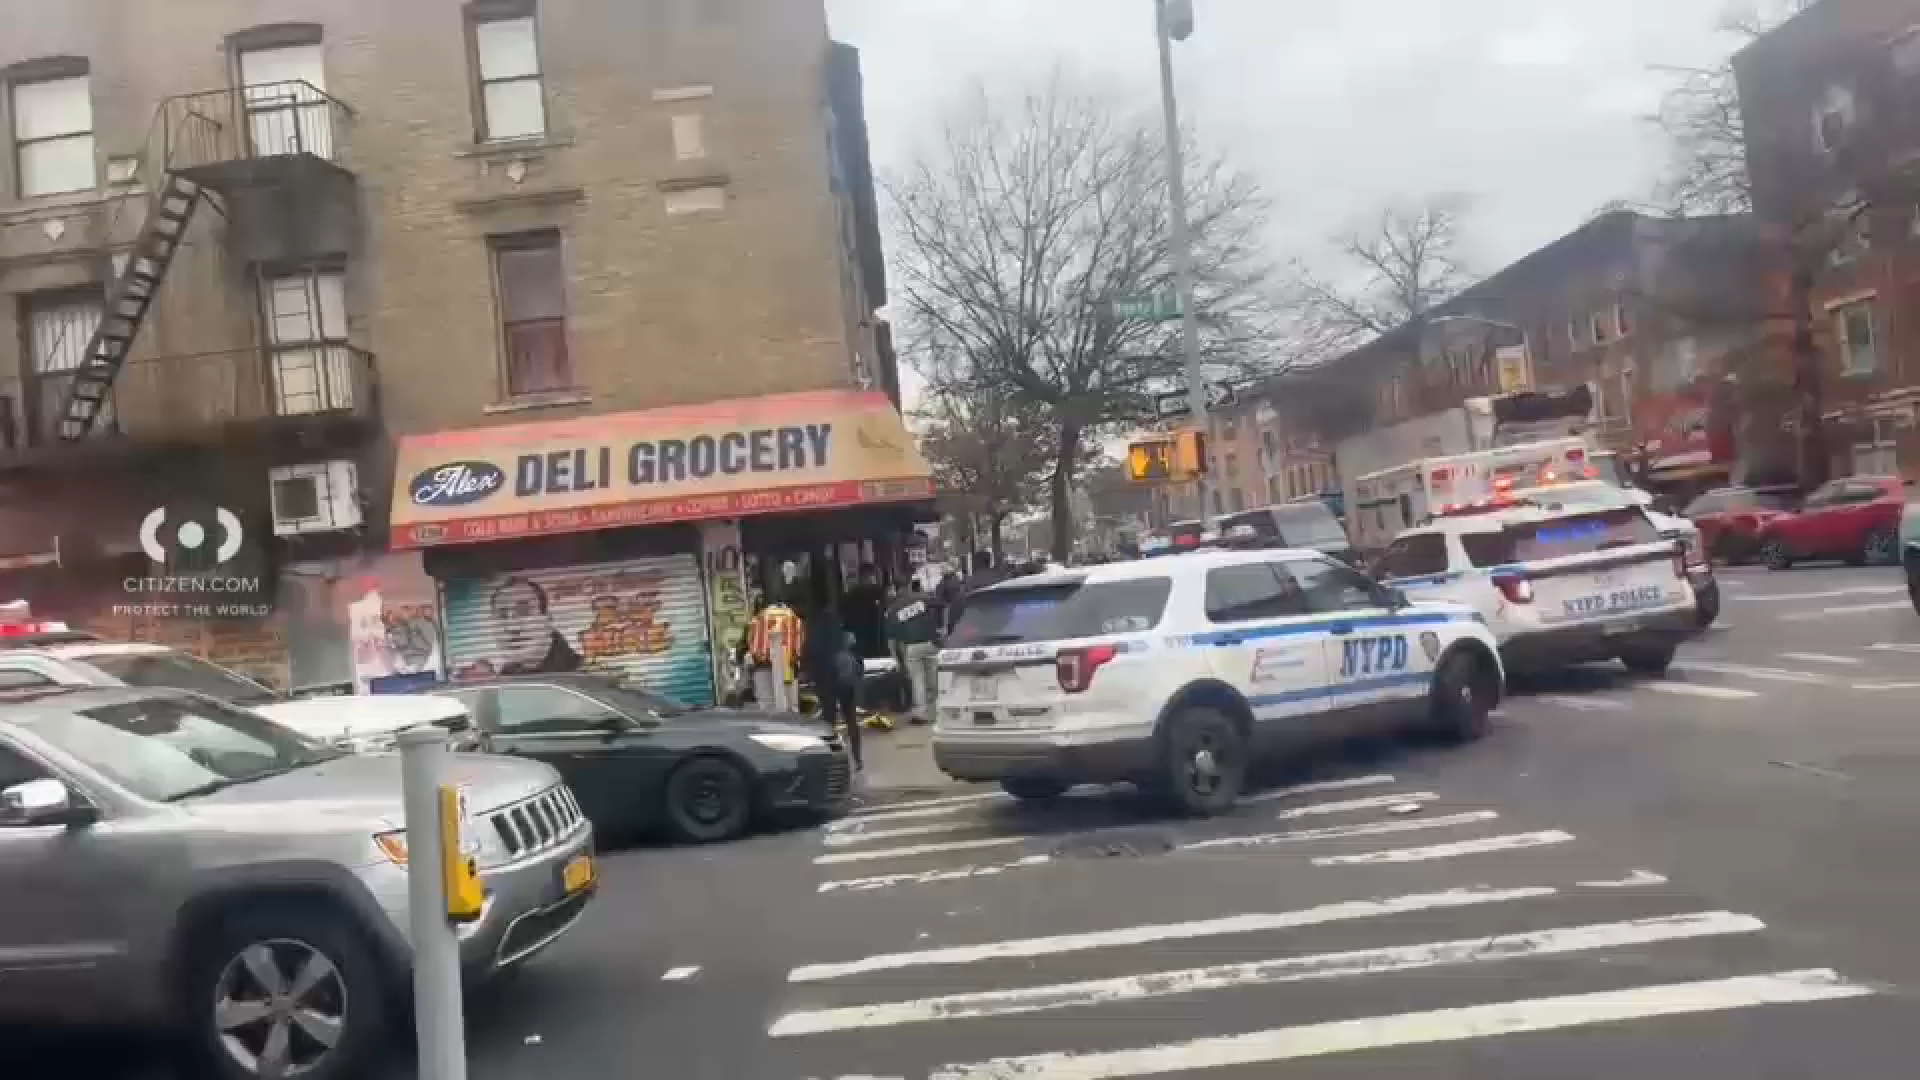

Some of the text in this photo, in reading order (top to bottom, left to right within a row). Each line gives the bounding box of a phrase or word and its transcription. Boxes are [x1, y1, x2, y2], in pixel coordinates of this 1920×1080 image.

[415, 424, 832, 502] Alex DELI GROCERY
[1340, 634, 1408, 677] NYPD
